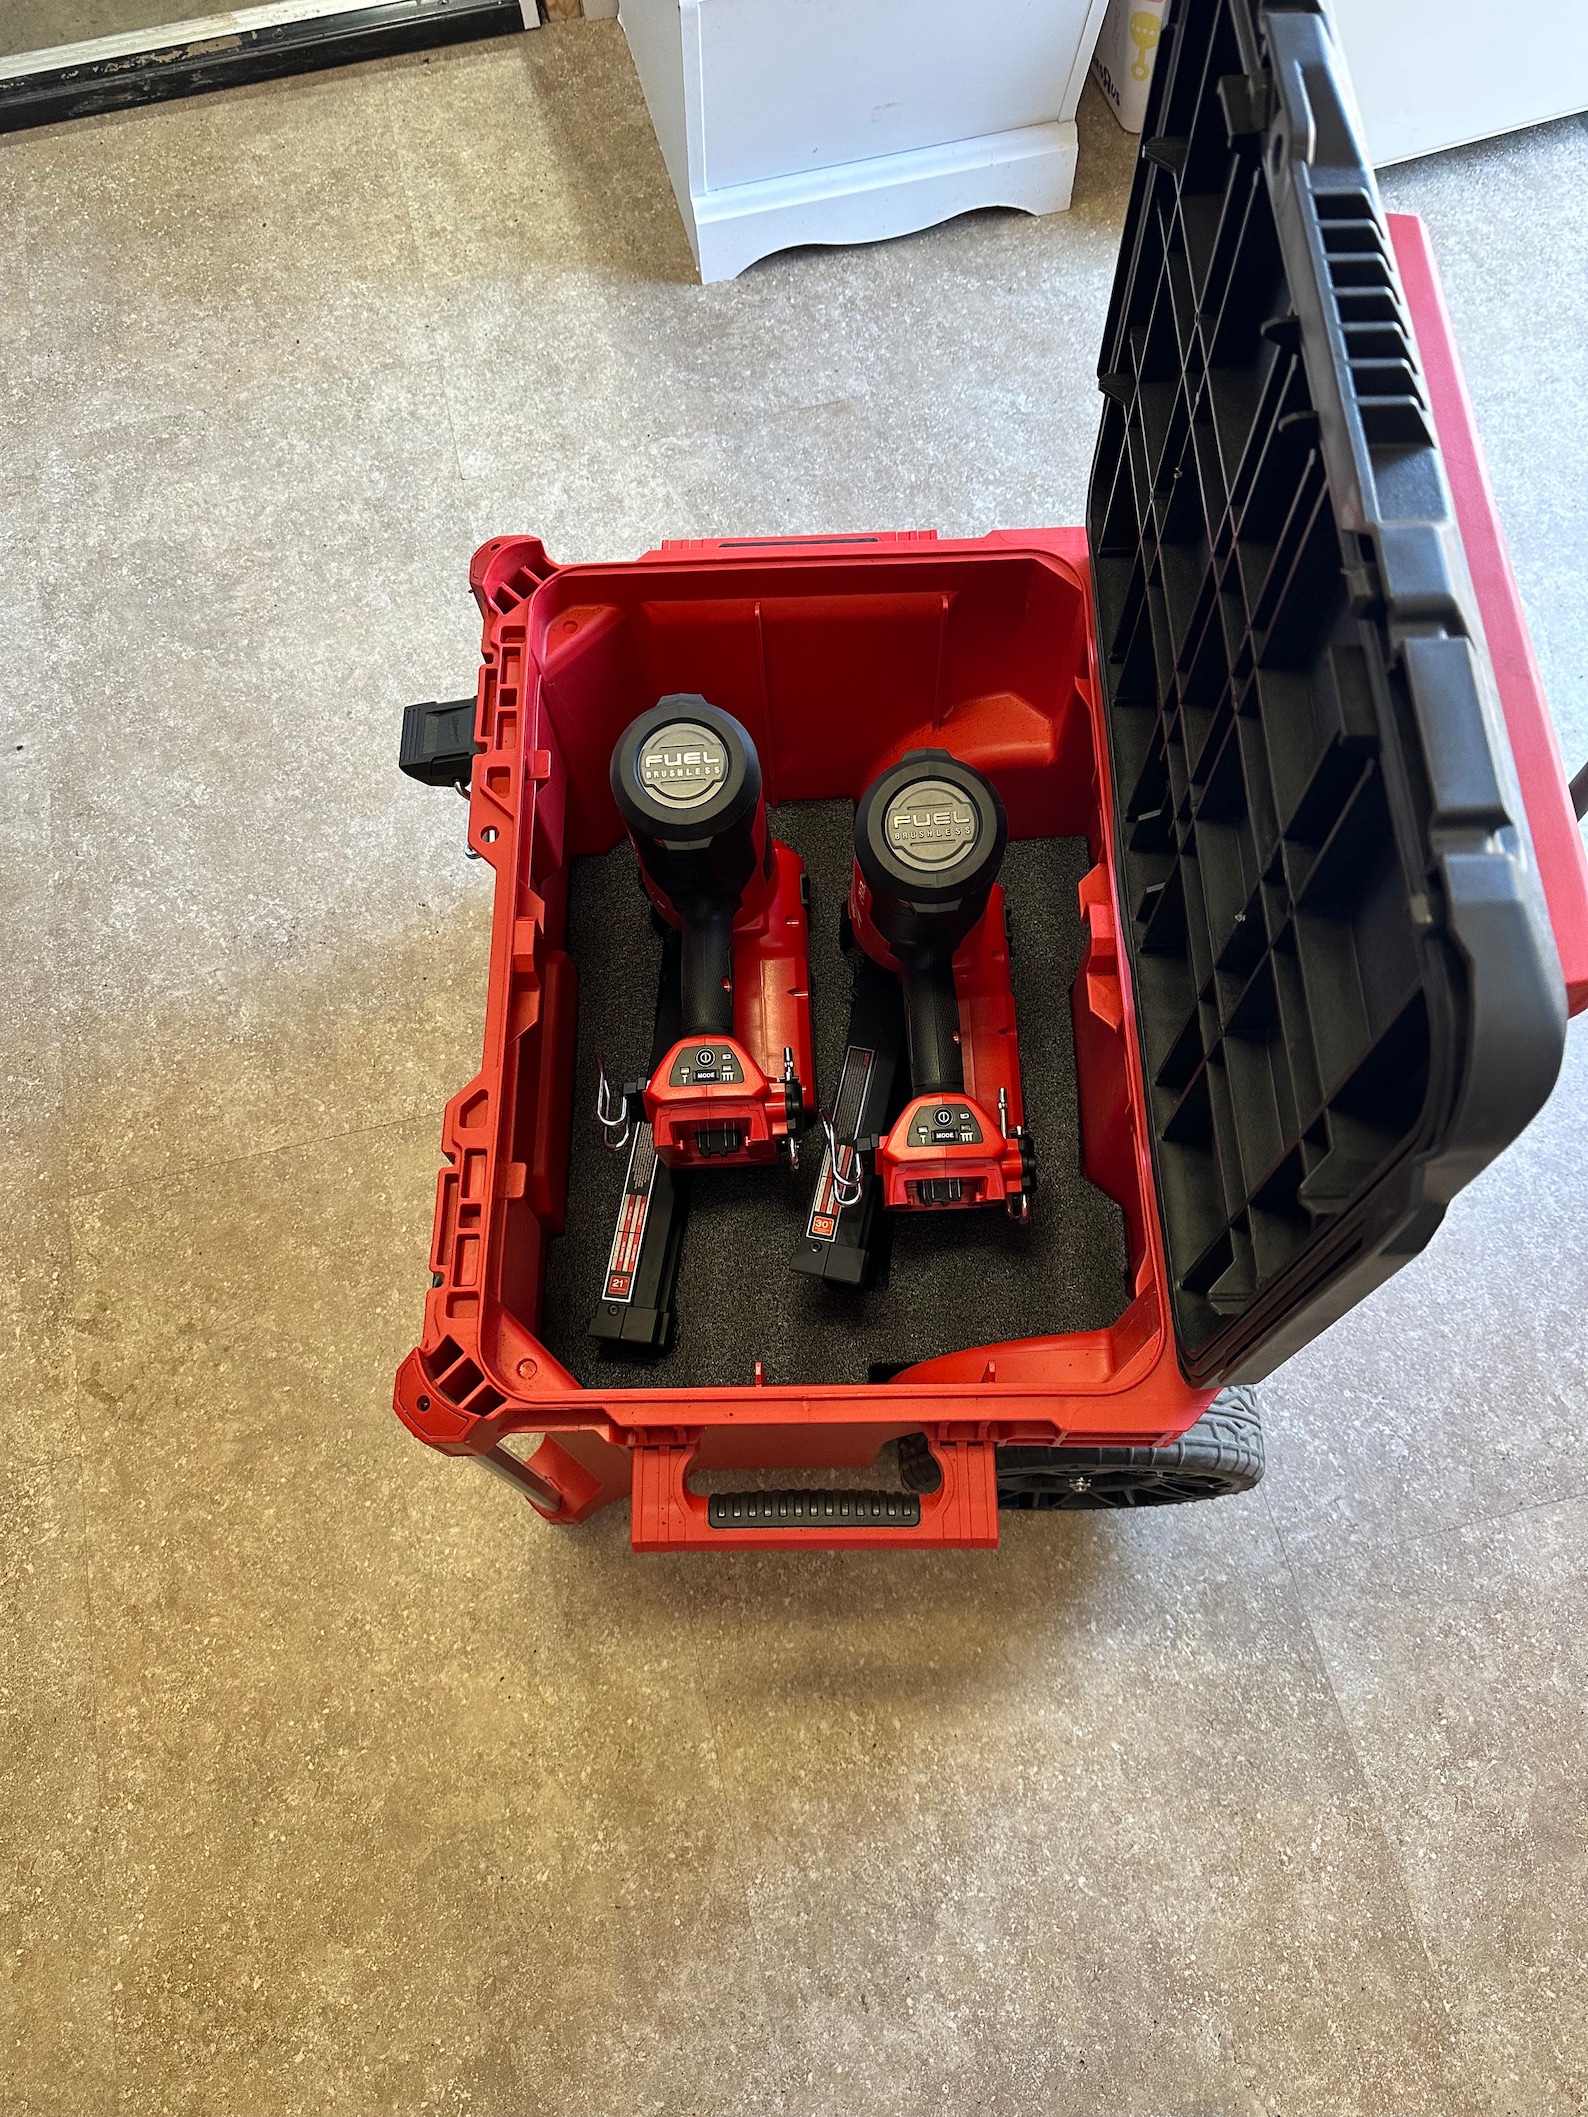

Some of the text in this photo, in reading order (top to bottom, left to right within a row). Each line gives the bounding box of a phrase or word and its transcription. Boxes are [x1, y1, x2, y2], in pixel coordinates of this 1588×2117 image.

[645, 751, 720, 768] FUEL
[645, 766, 721, 779] BRUSHLESS
[893, 810, 970, 829] FUEL
[894, 826, 972, 840] BRUSHLESS
[697, 1071, 716, 1079] MODE
